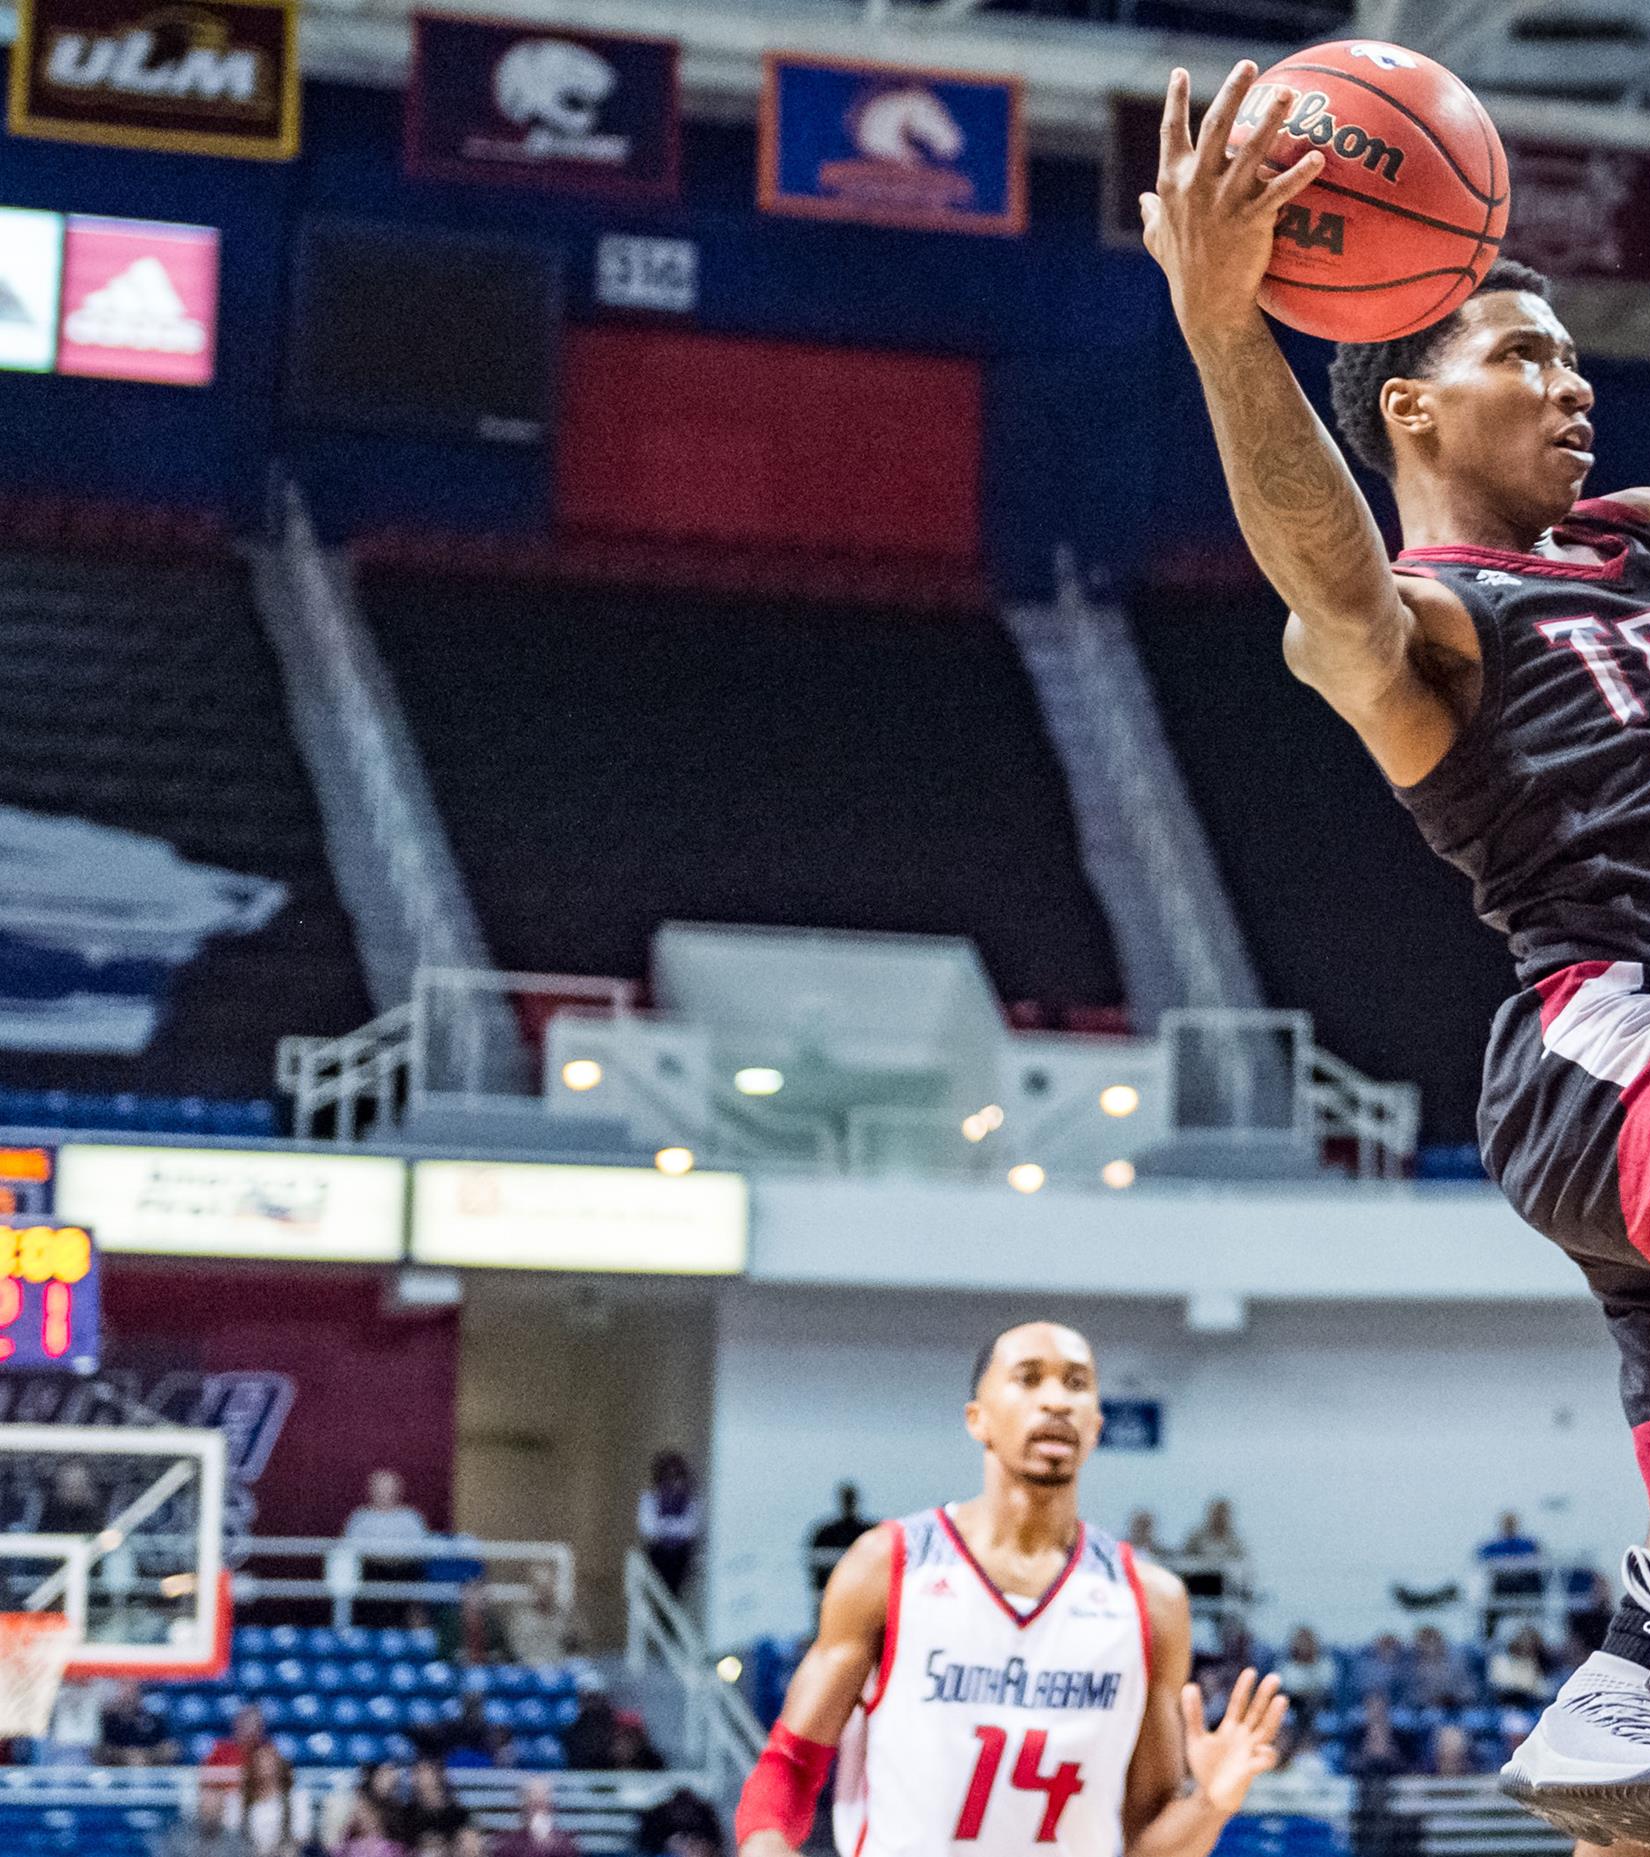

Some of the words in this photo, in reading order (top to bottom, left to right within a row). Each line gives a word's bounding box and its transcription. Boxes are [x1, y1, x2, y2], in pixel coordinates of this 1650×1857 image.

[46, 31, 258, 101] ULM
[1235, 83, 1406, 184] Wlson
[954, 1724, 1084, 1843] 14
